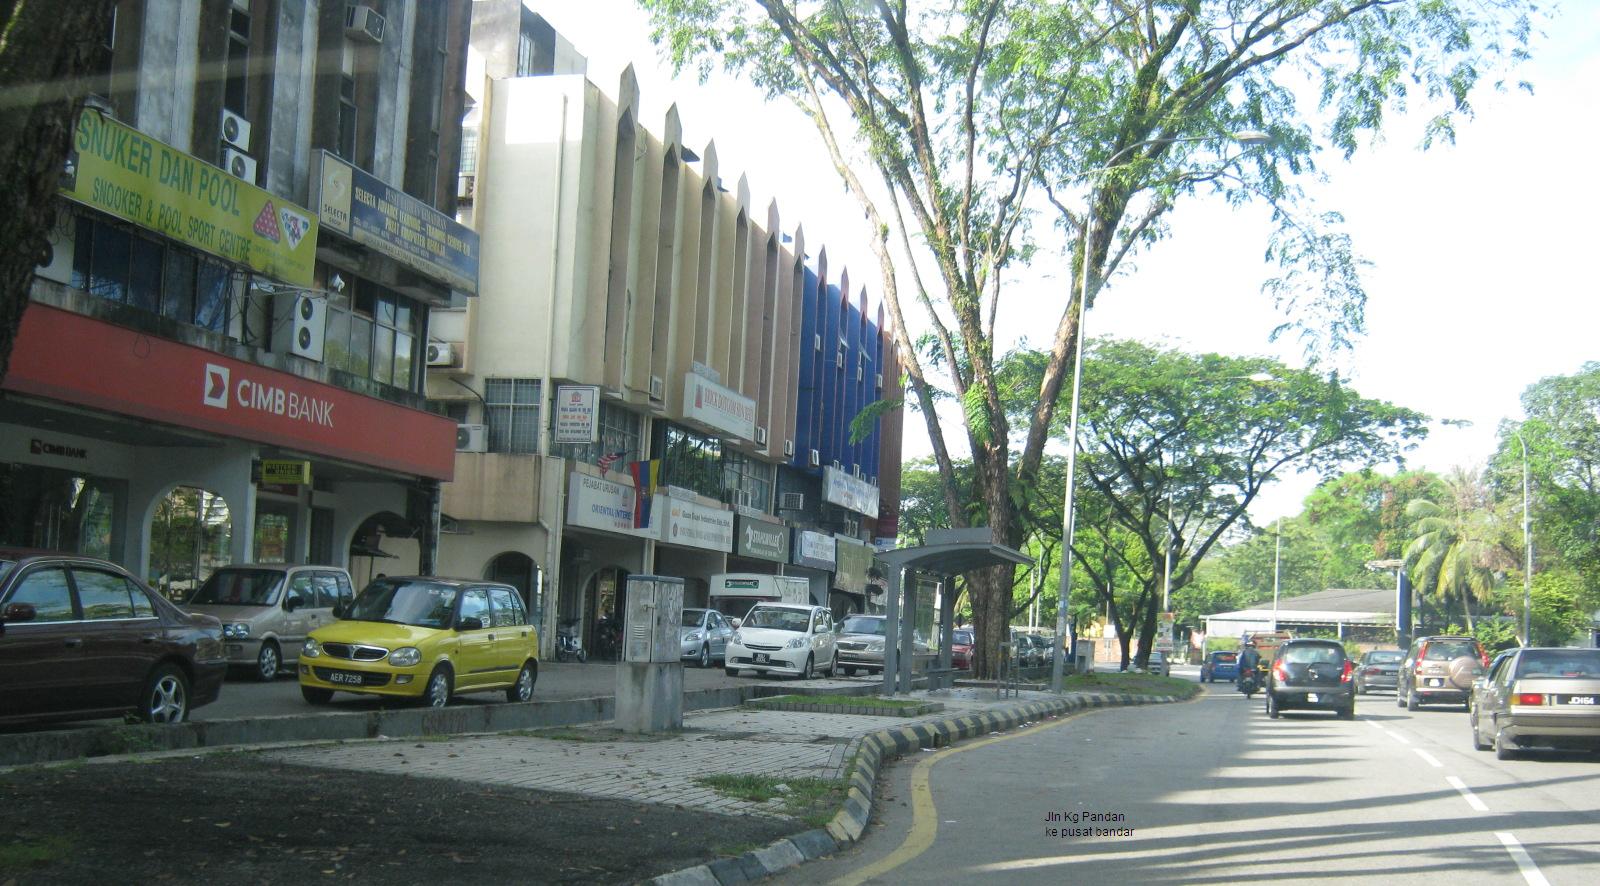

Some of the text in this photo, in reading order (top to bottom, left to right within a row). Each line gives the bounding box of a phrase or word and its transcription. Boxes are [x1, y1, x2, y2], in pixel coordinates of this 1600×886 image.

[79, 111, 240, 216] SNUKER DAN POOL
[355, 186, 376, 209] SELECTA
[92, 177, 142, 217] SNOOKER
[146, 200, 153, 222] &
[158, 204, 182, 234] POOL
[187, 216, 216, 248] SPORT
[219, 228, 252, 261] CENTRE
[324, 204, 347, 223] SELECTA
[237, 379, 335, 427] CIMB BANK
[583, 478, 619, 495] PEJABAT URUSAN
[591, 504, 632, 521] ORIENTAL INTERE
[330, 673, 362, 684] AER 7258
